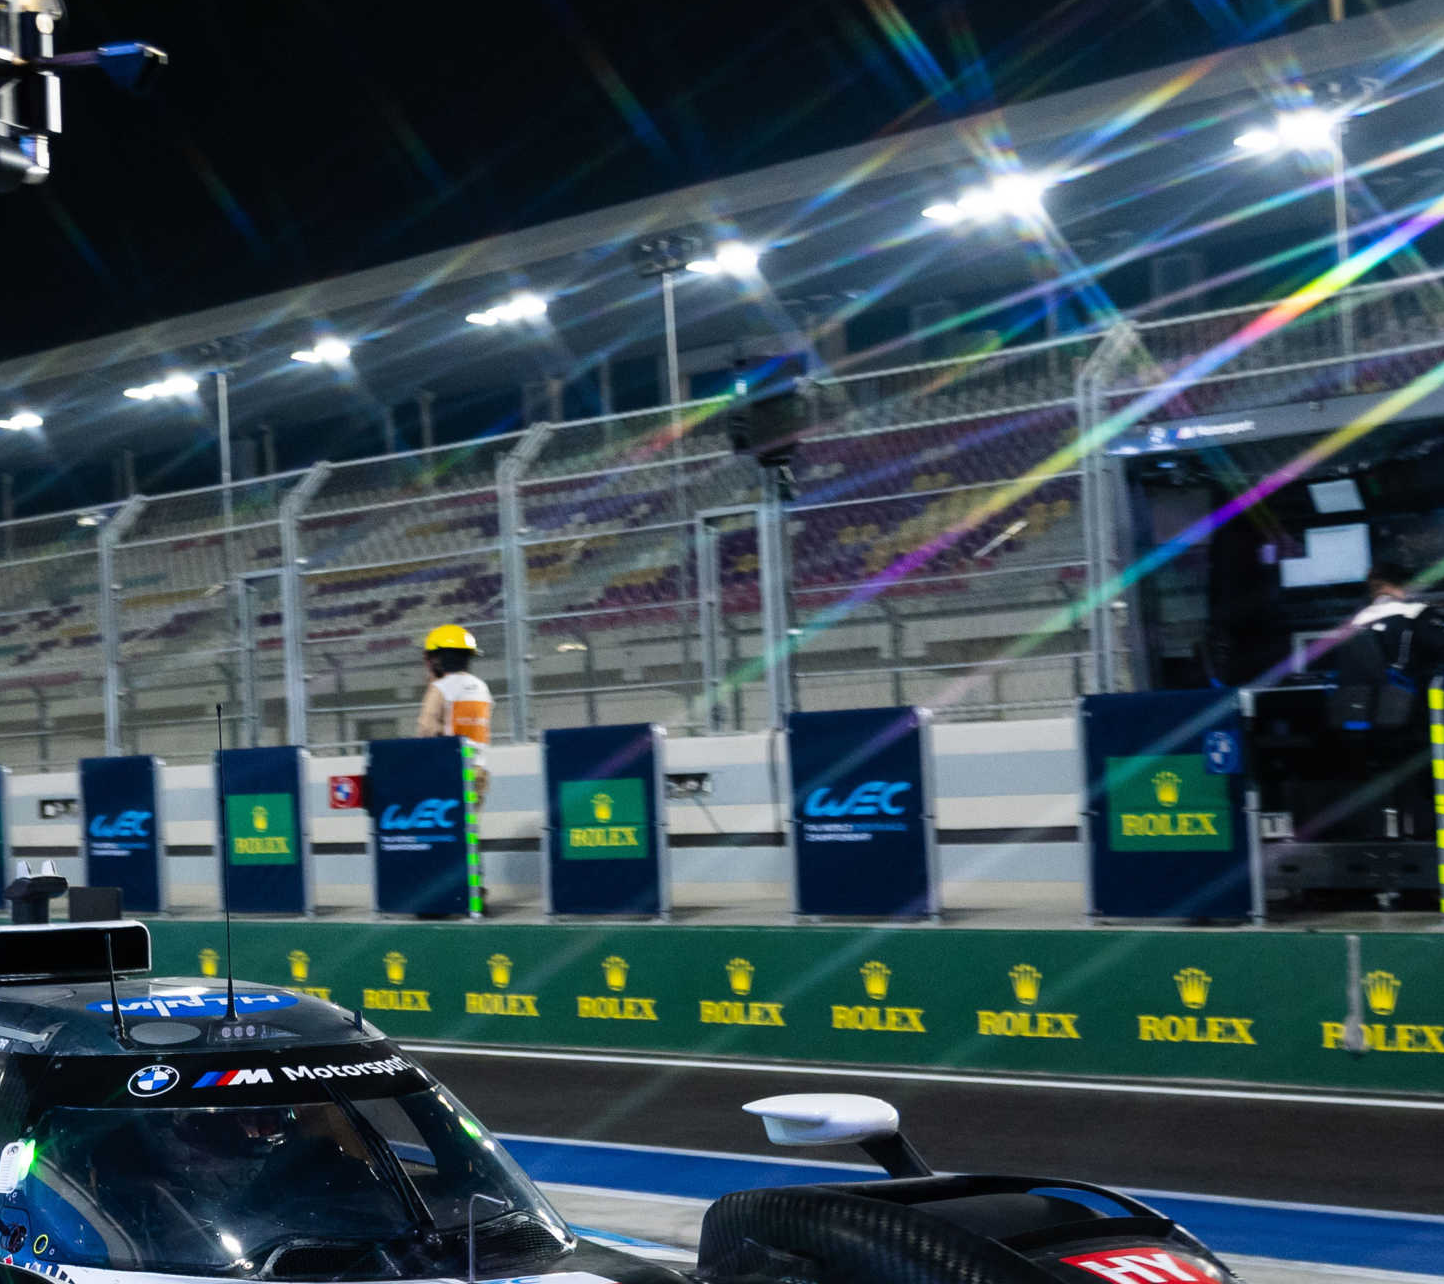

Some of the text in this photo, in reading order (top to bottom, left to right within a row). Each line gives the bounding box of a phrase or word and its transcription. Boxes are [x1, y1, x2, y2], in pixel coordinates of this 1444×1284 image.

[804, 781, 912, 817] WEC
[380, 798, 460, 830] WEC
[1120, 812, 1218, 836] ROLEX
[569, 826, 639, 848] ROLEX
[362, 988, 432, 1012] ROLEX
[464, 992, 541, 1017] ROLEX
[576, 996, 660, 1022] ROLEX
[699, 1000, 786, 1027] ROLEX
[831, 1005, 928, 1033] ROLEX
[976, 1010, 1082, 1040] ROLEX
[1138, 1014, 1258, 1046] ROLEX
[280, 1054, 415, 1082] Motorsport
